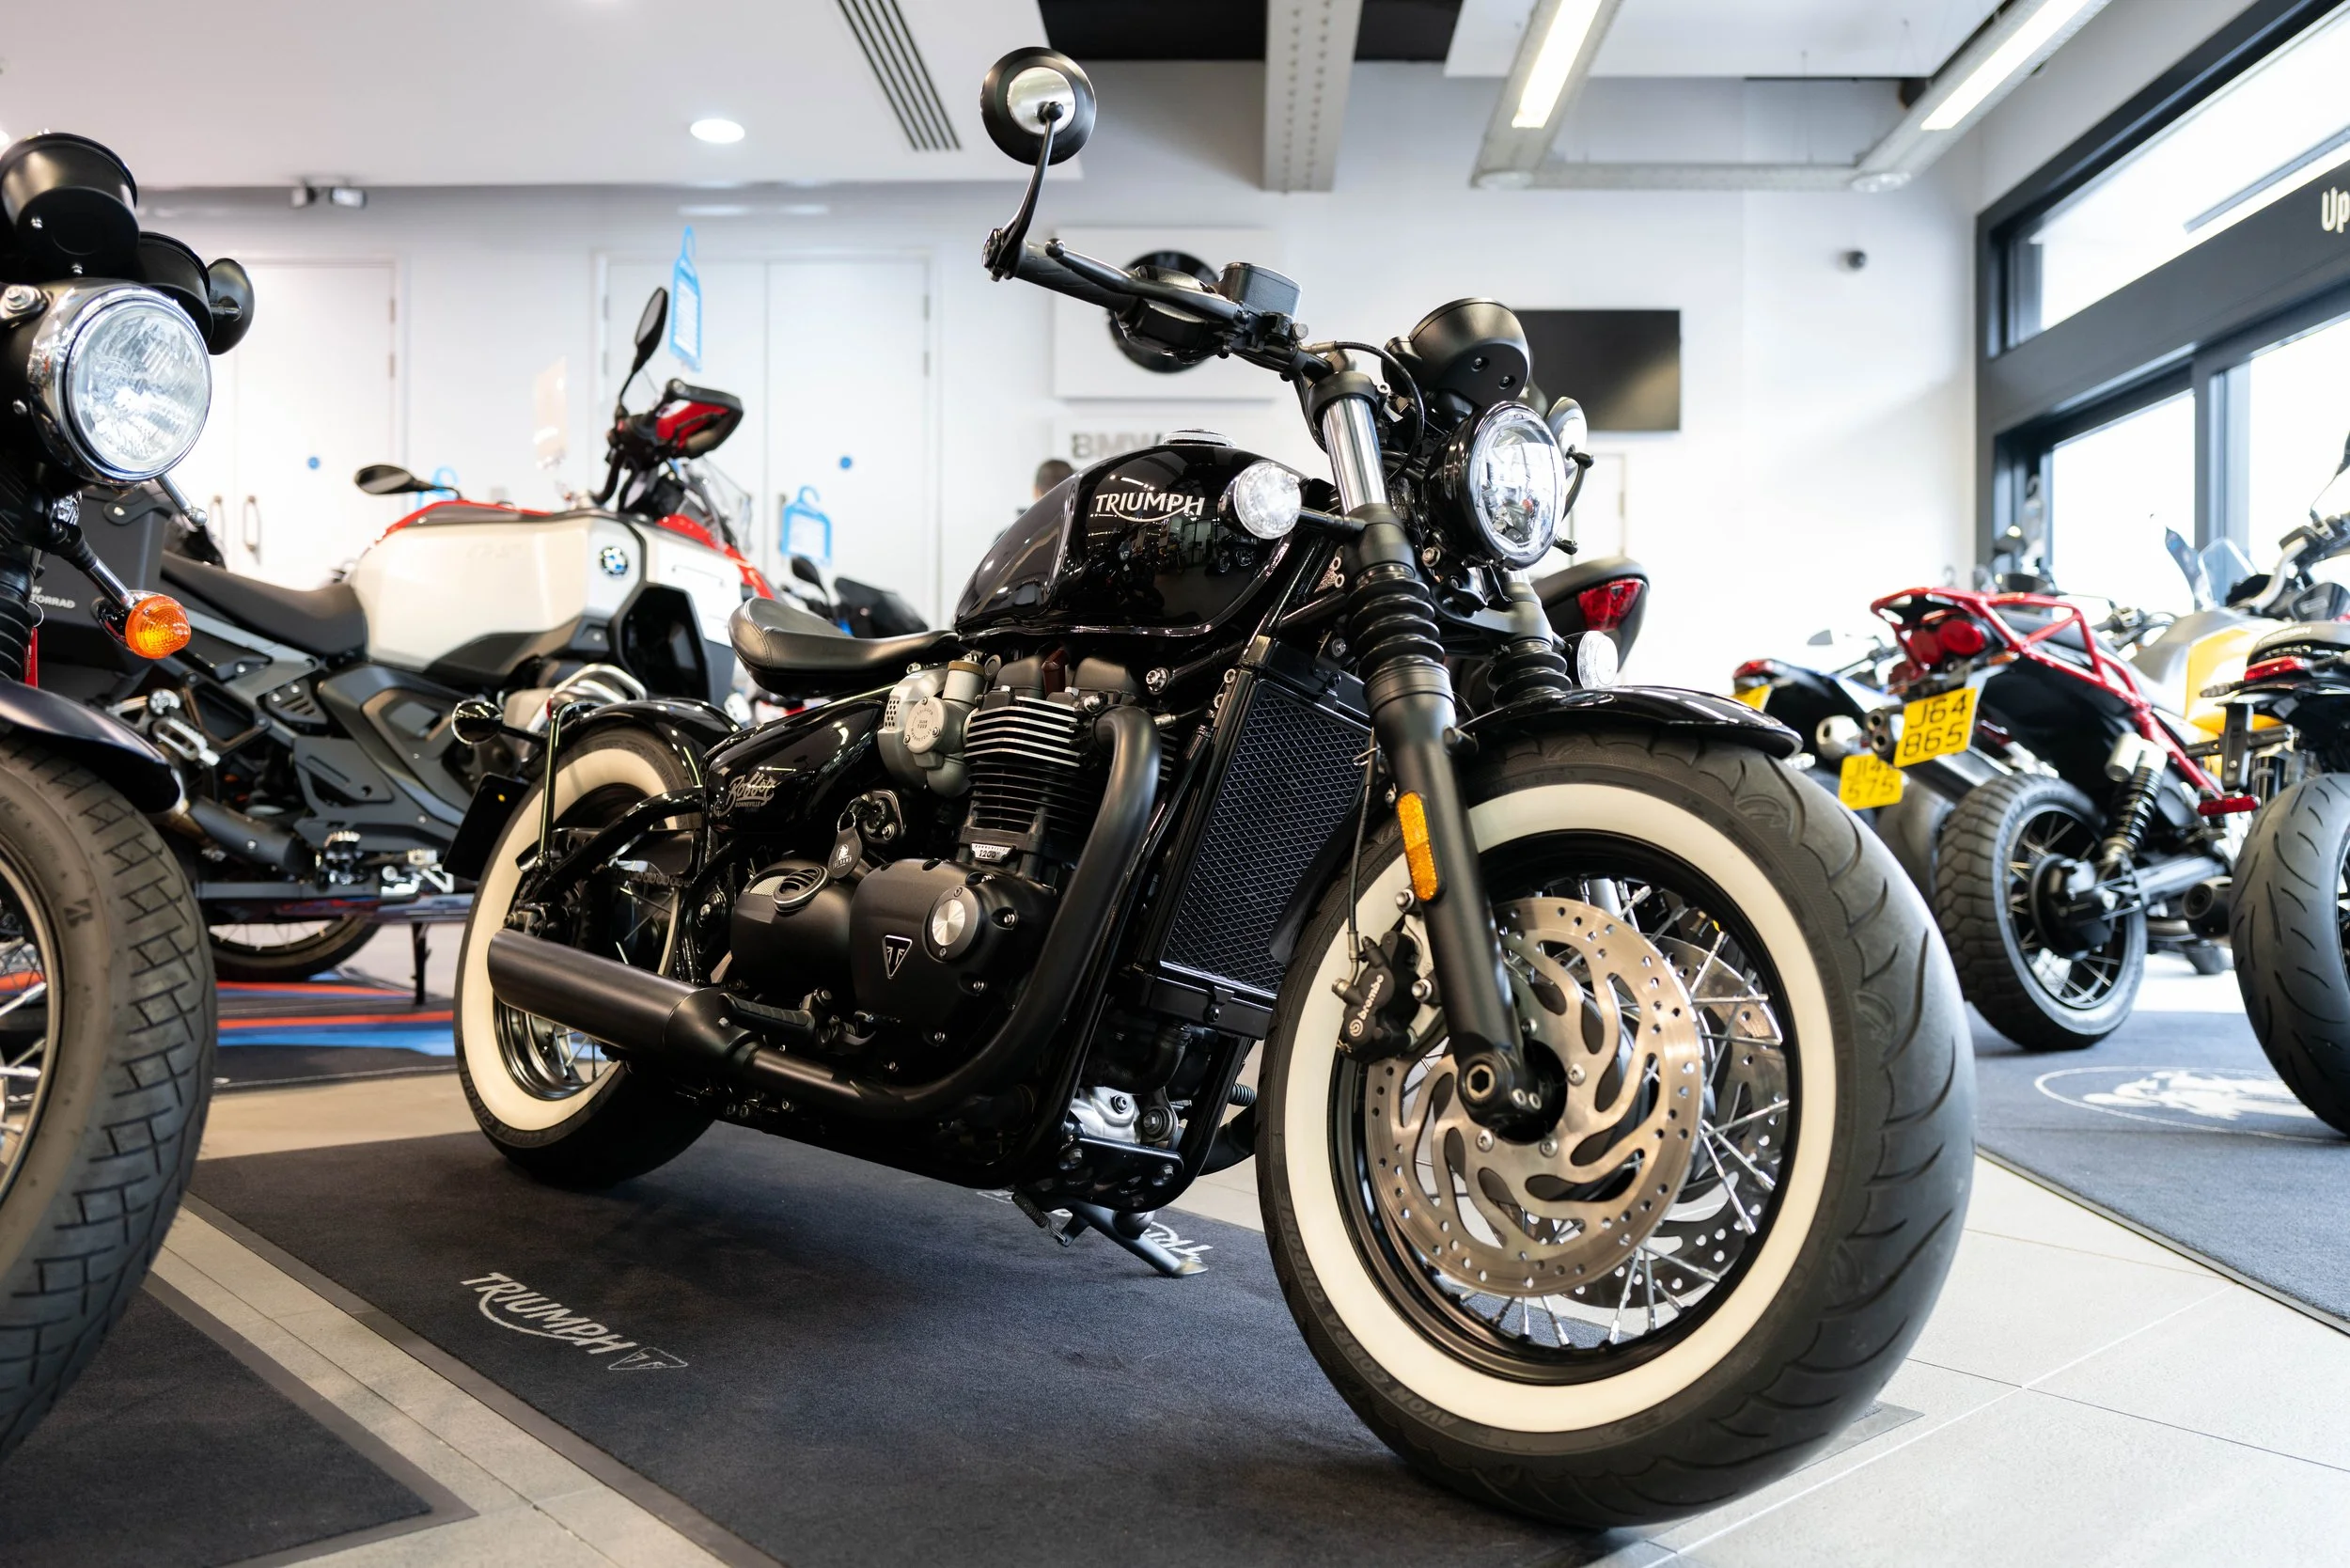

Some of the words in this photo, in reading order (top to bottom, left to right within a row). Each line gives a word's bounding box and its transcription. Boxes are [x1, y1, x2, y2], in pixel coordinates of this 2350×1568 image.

[1095, 492, 1206, 523] TRIUMPH
[30, 593, 76, 609] TORRAD
[1909, 693, 1967, 729] J64
[1903, 721, 1964, 758] 865
[1846, 773, 1896, 803] 575
[979, 849, 997, 859] 1200
[1356, 974, 1385, 1021] brembo
[1277, 1187, 1326, 1305] CHROME
[459, 1272, 638, 1355] TRIUMPH
[1324, 1312, 1390, 1384] COBRA
[1389, 1386, 1462, 1429] AVON
